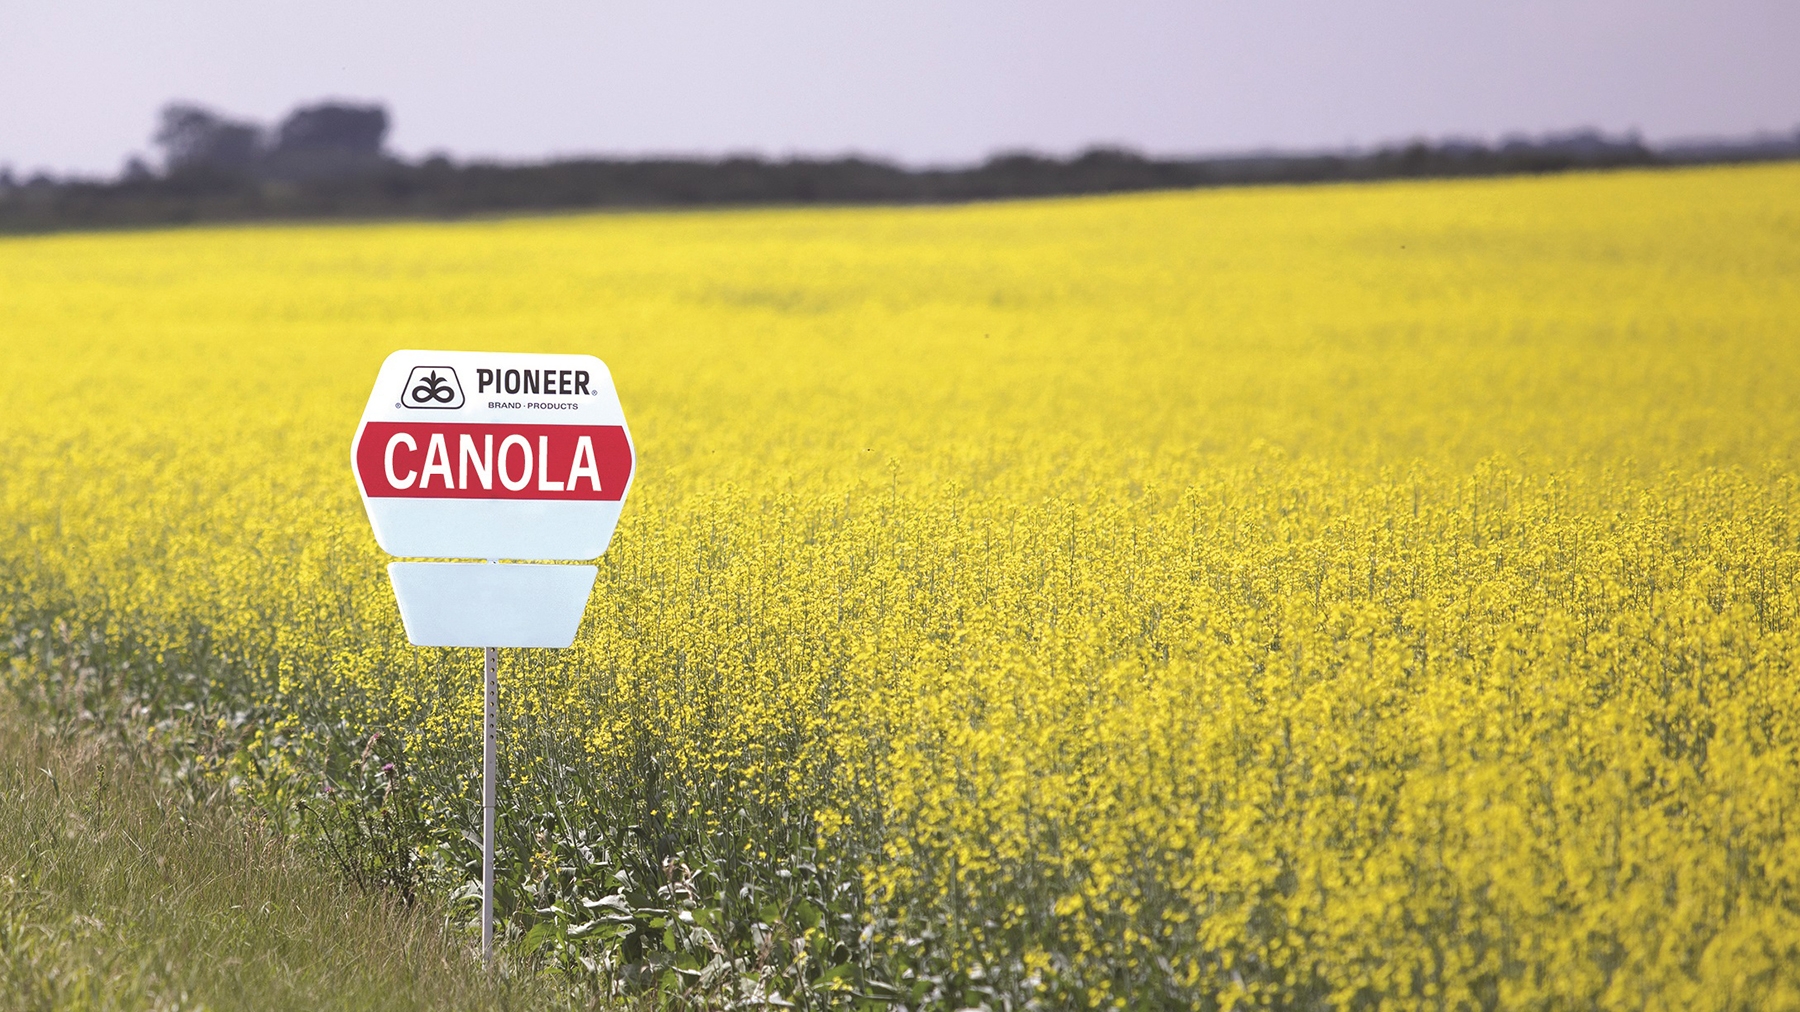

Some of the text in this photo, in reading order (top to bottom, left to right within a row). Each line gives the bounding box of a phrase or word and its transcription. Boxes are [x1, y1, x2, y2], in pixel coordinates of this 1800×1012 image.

[476, 368, 590, 396] PIONEER
[488, 401, 579, 410] BRAND PRODUCTS
[384, 432, 602, 492] CANOLA
